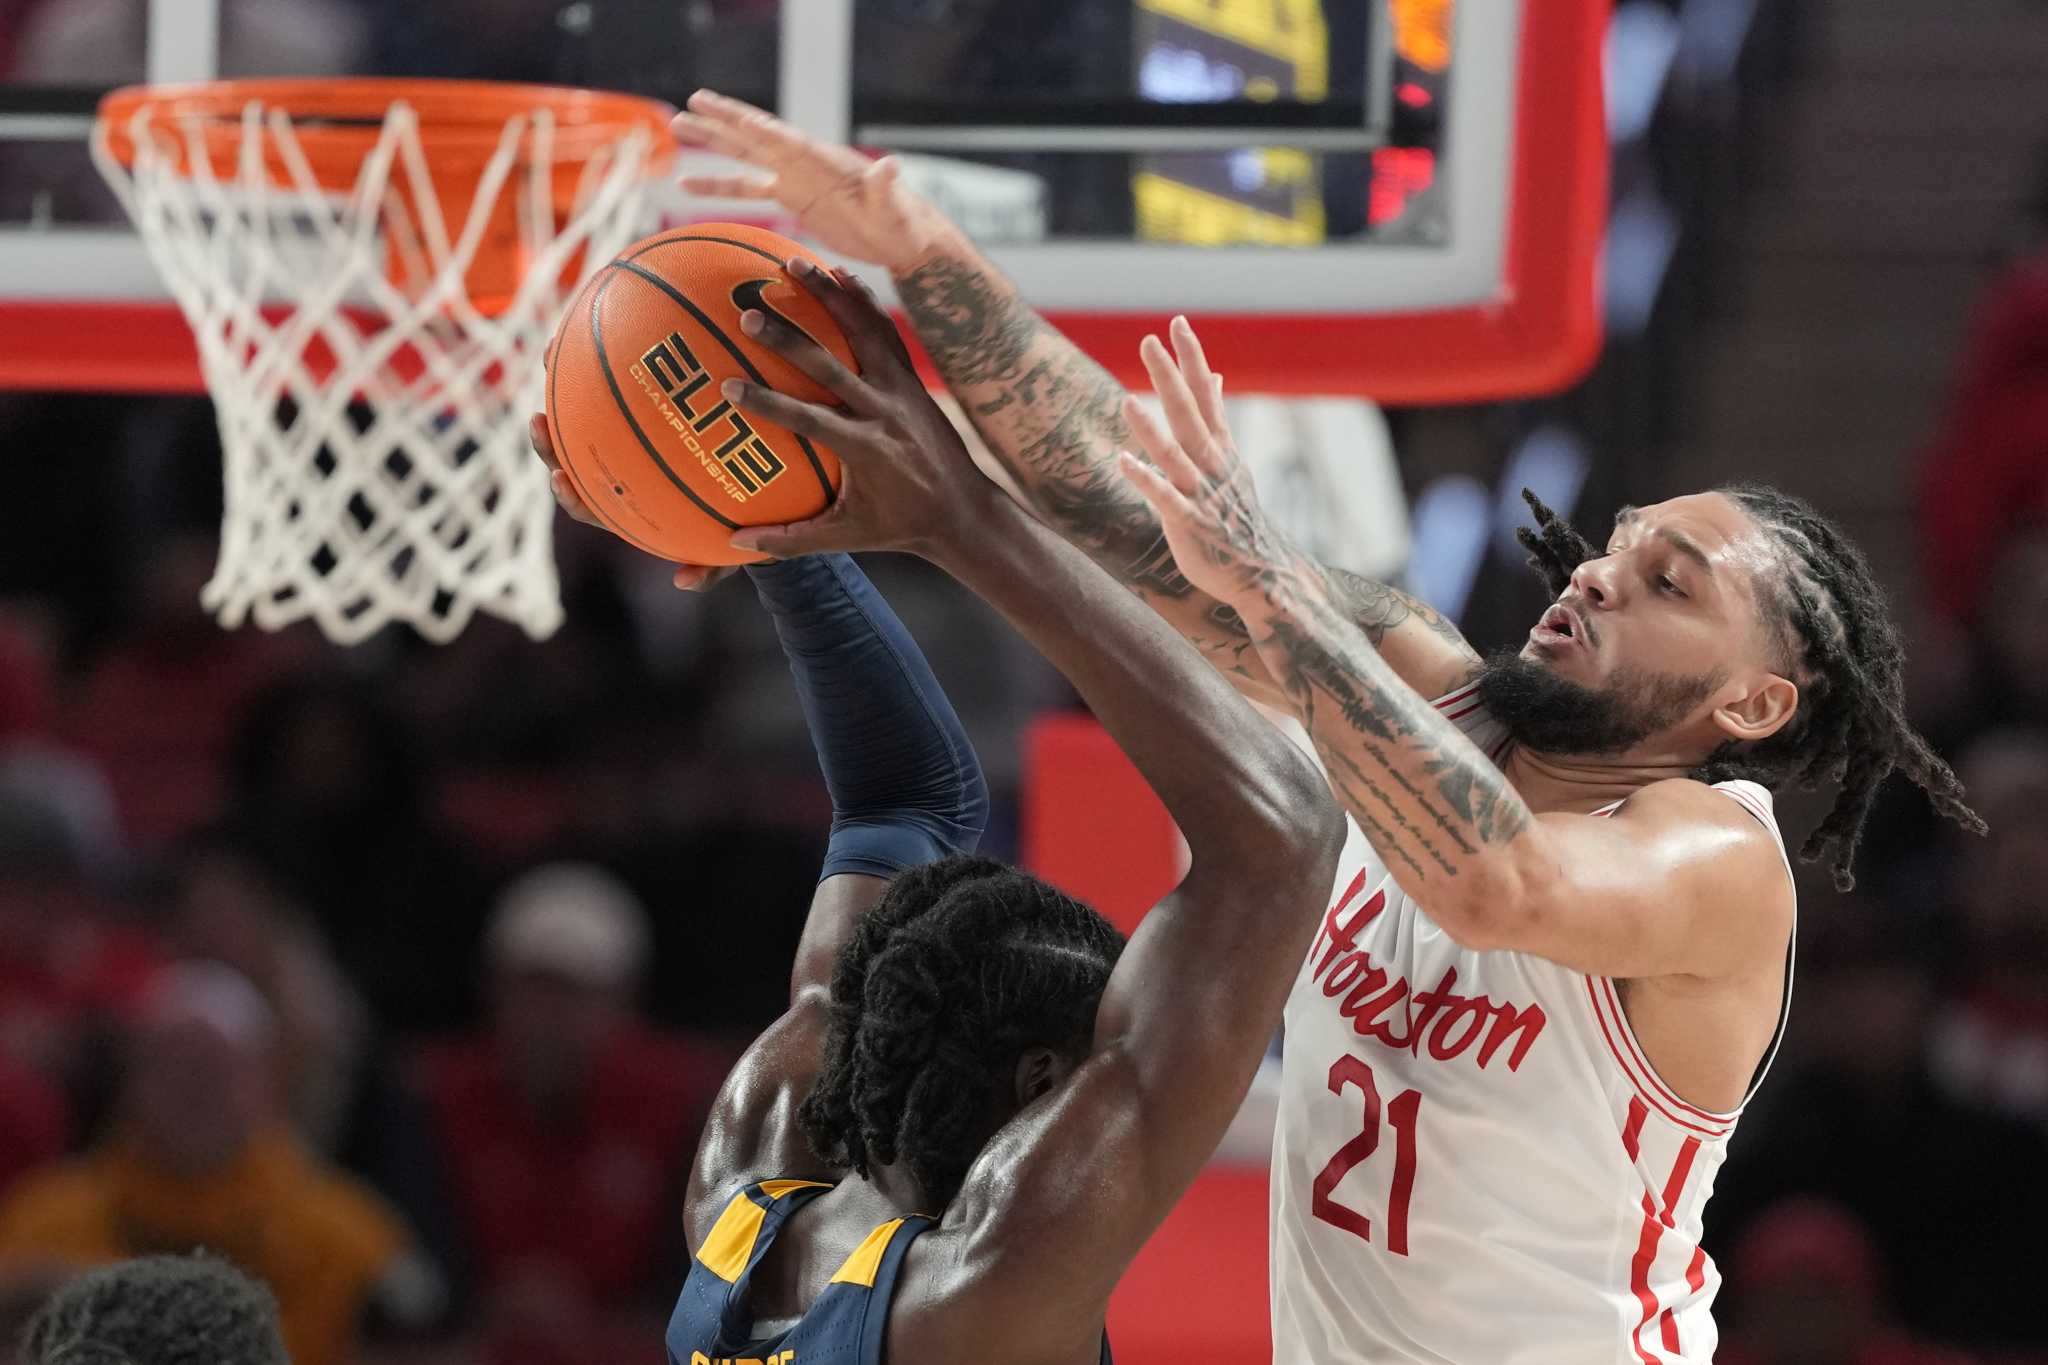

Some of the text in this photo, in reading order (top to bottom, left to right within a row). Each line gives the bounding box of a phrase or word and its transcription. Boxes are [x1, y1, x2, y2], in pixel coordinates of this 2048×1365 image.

[629, 364, 747, 503] CHAMPIONSHIP
[639, 331, 787, 496] ELITE
[1309, 866, 1547, 1073] Houston
[1311, 1053, 1422, 1257] 21
